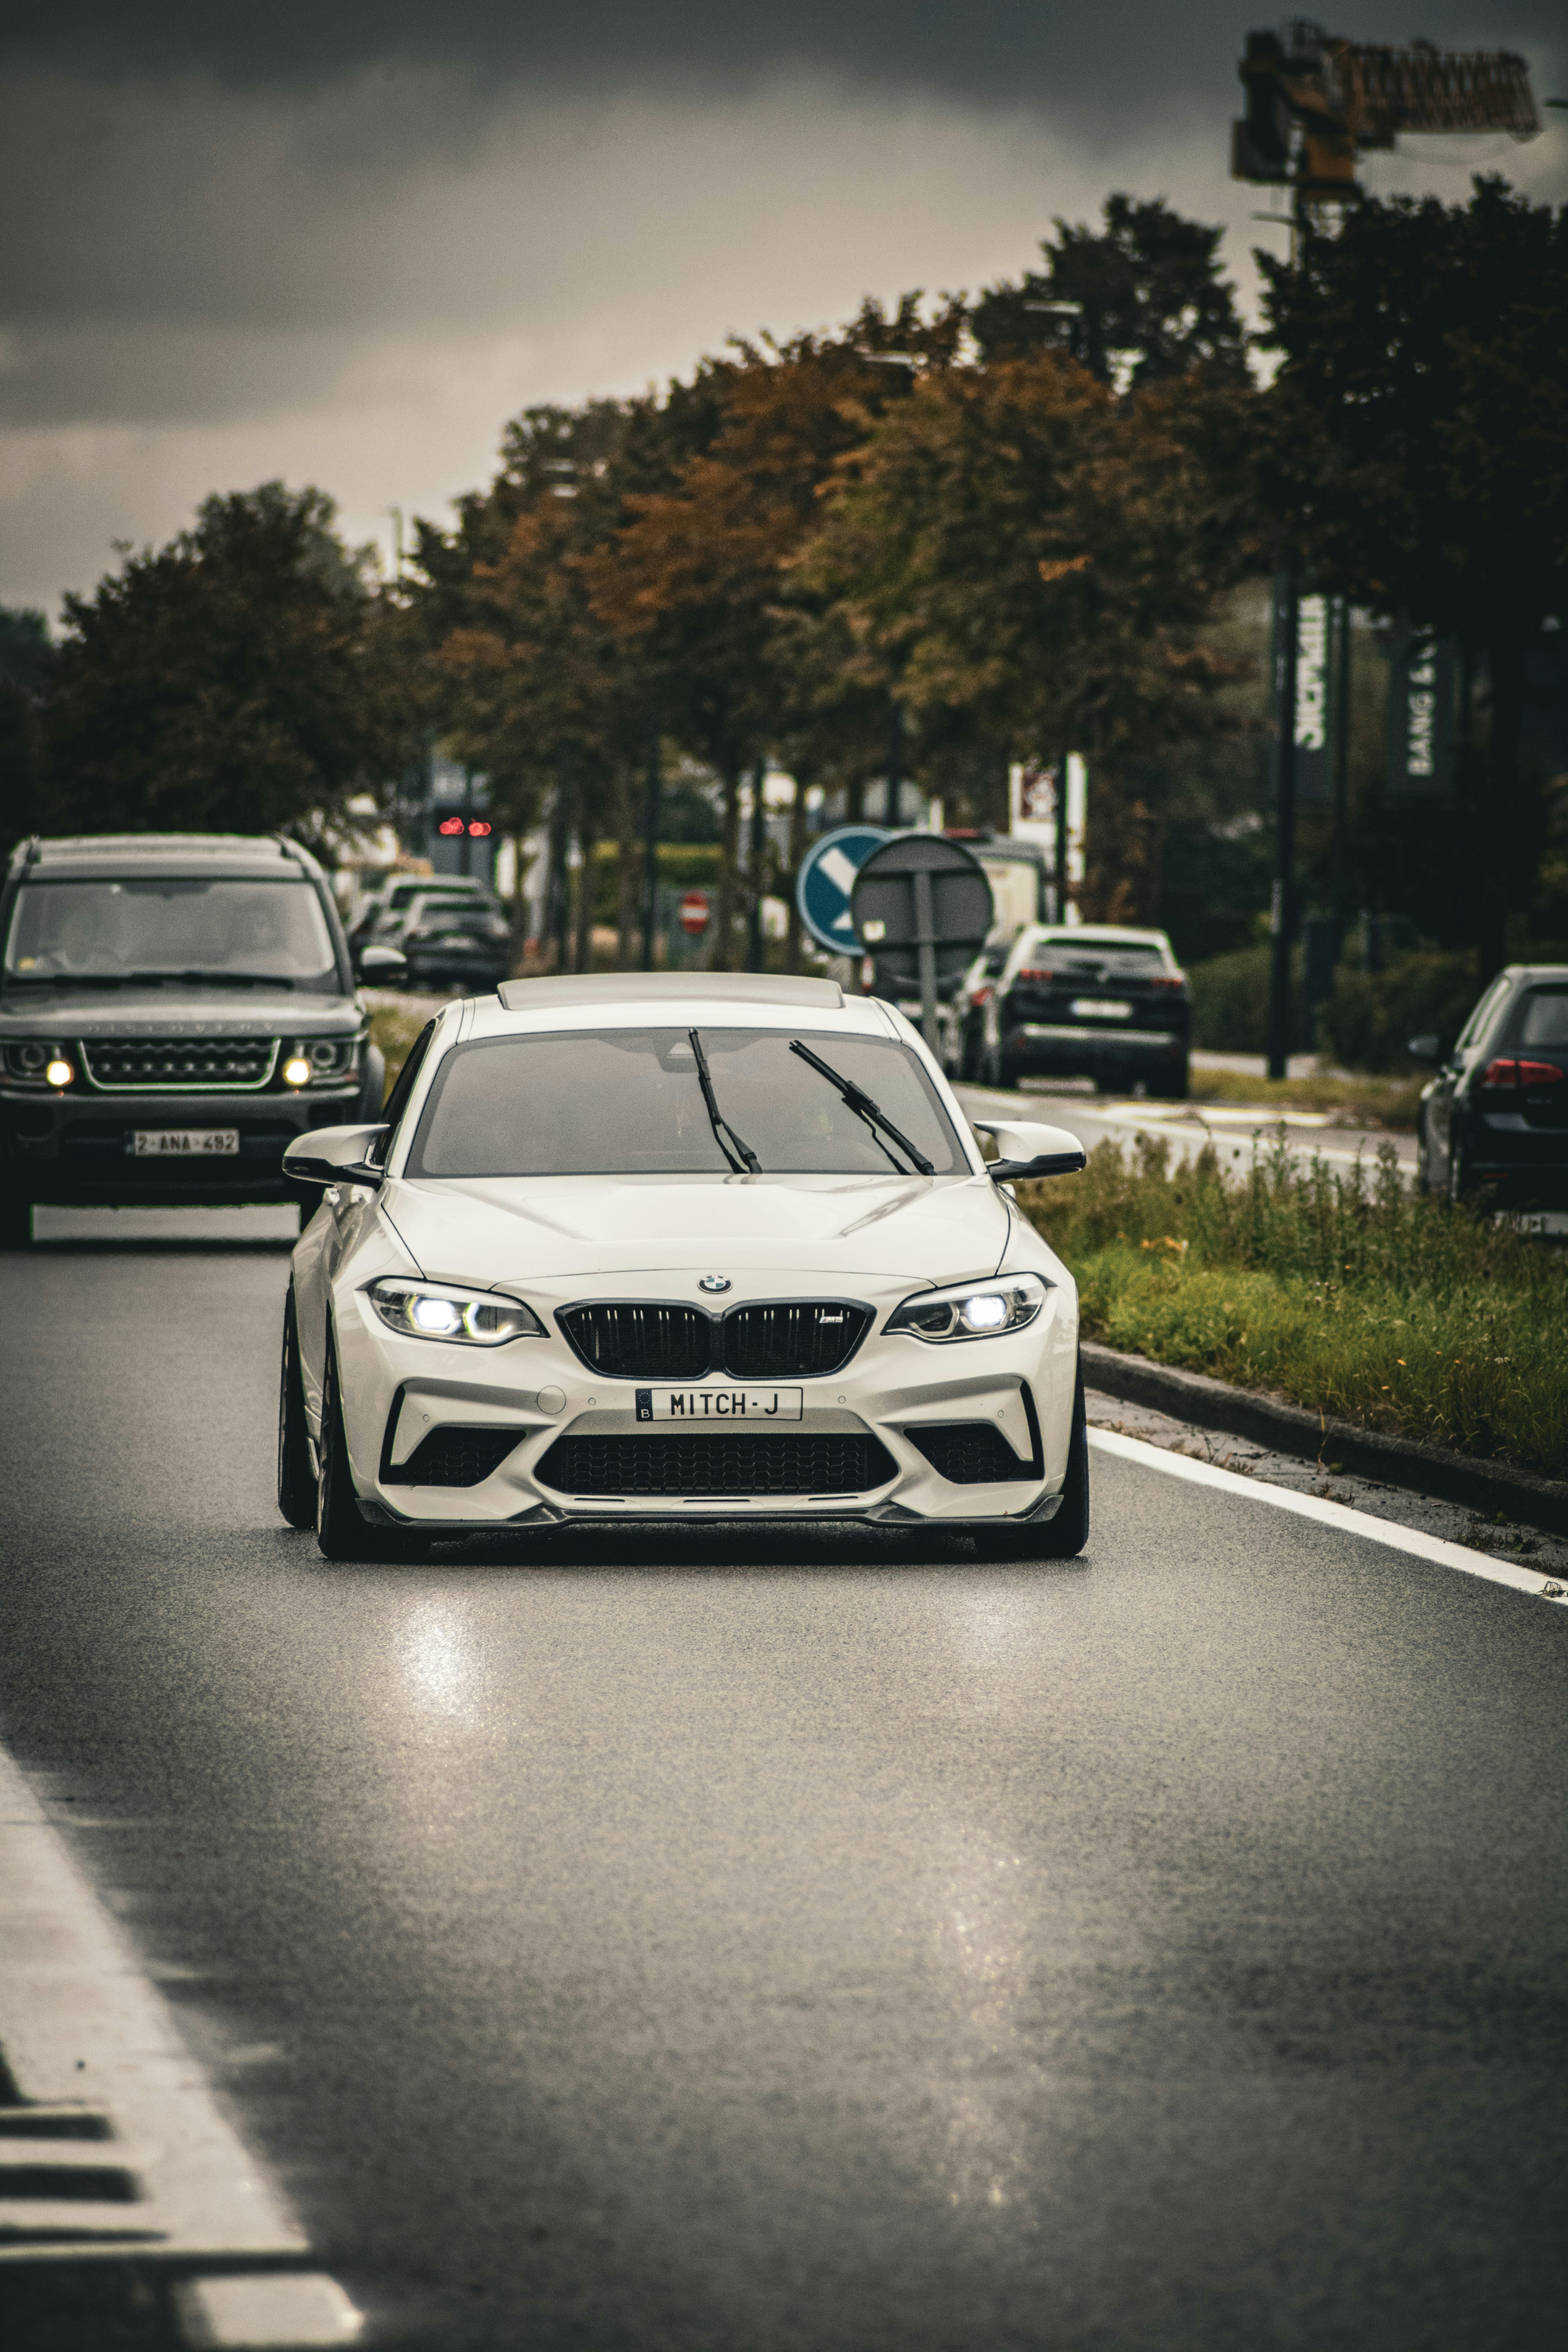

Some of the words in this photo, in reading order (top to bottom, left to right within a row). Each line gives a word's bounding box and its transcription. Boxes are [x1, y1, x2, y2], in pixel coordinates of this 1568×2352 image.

[1406, 692, 1435, 776] BANG
[641, 1409, 650, 1418] B
[670, 1393, 778, 1415] MITCH-J
